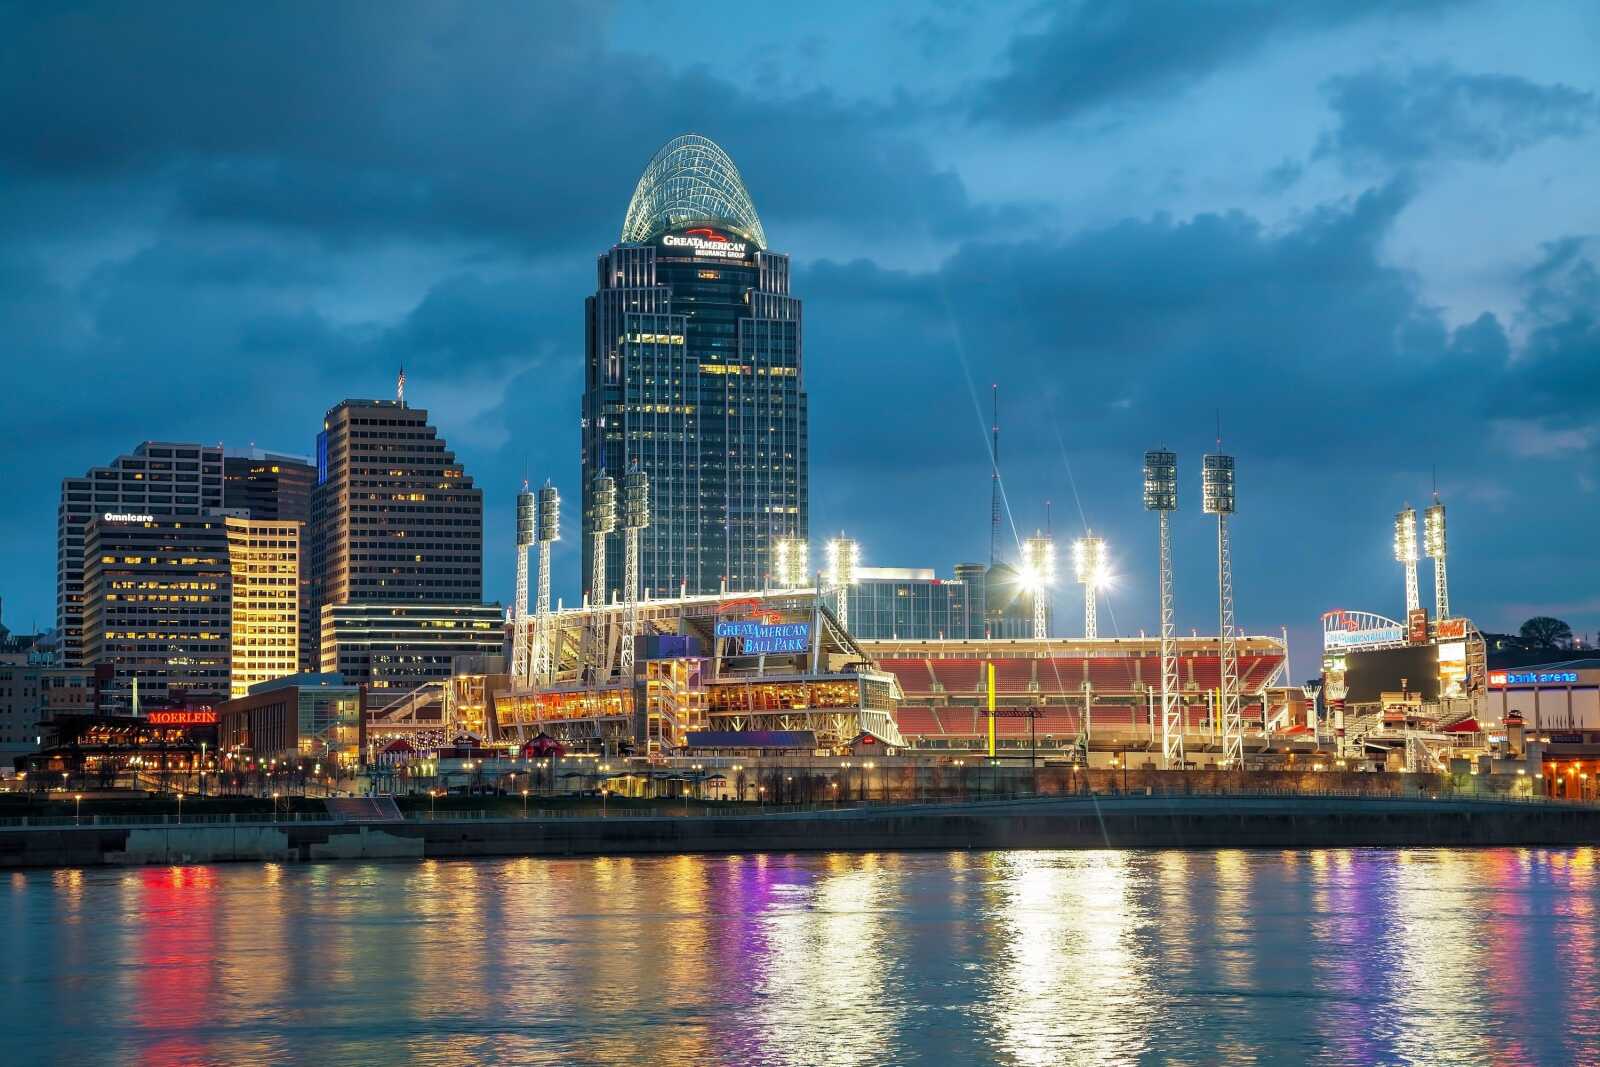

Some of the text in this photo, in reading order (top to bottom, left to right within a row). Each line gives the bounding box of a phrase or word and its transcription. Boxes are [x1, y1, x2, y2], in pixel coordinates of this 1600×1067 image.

[695, 249, 746, 259] INSURANCE GROUP
[104, 512, 154, 522] Omnicare
[752, 623, 809, 638] AMERICAN
[745, 638, 804, 653] BALL PARK
[1540, 672, 1577, 683] arena
[148, 712, 217, 724] MOERLEIN
